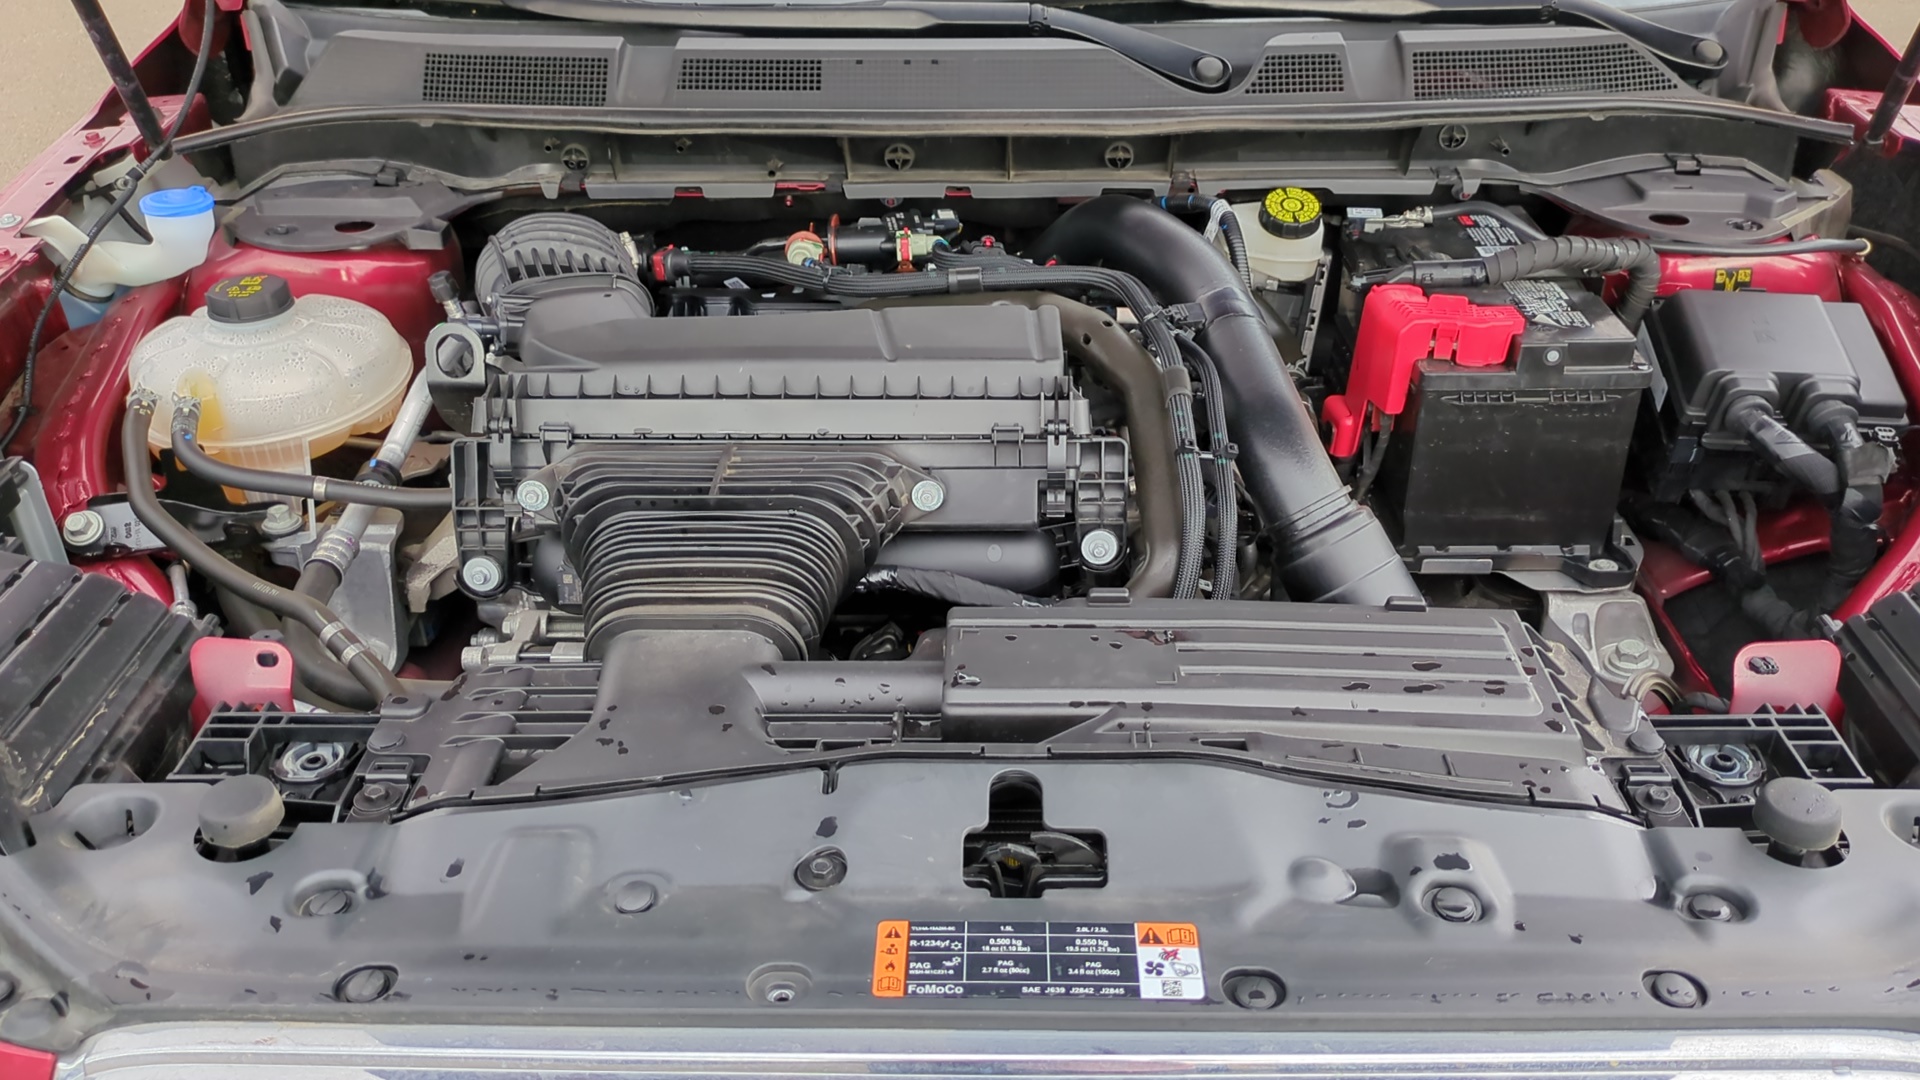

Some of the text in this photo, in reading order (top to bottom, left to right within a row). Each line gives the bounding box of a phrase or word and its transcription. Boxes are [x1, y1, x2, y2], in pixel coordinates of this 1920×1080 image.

[909, 939, 950, 948] R-1234yf
[1012, 938, 1022, 946] kg
[1075, 938, 1109, 947] 0.550 kg
[907, 984, 964, 994] FoMoCo
[1021, 986, 1041, 994] SAE
[1044, 986, 1066, 994] J639
[1099, 987, 1125, 995] J2845
